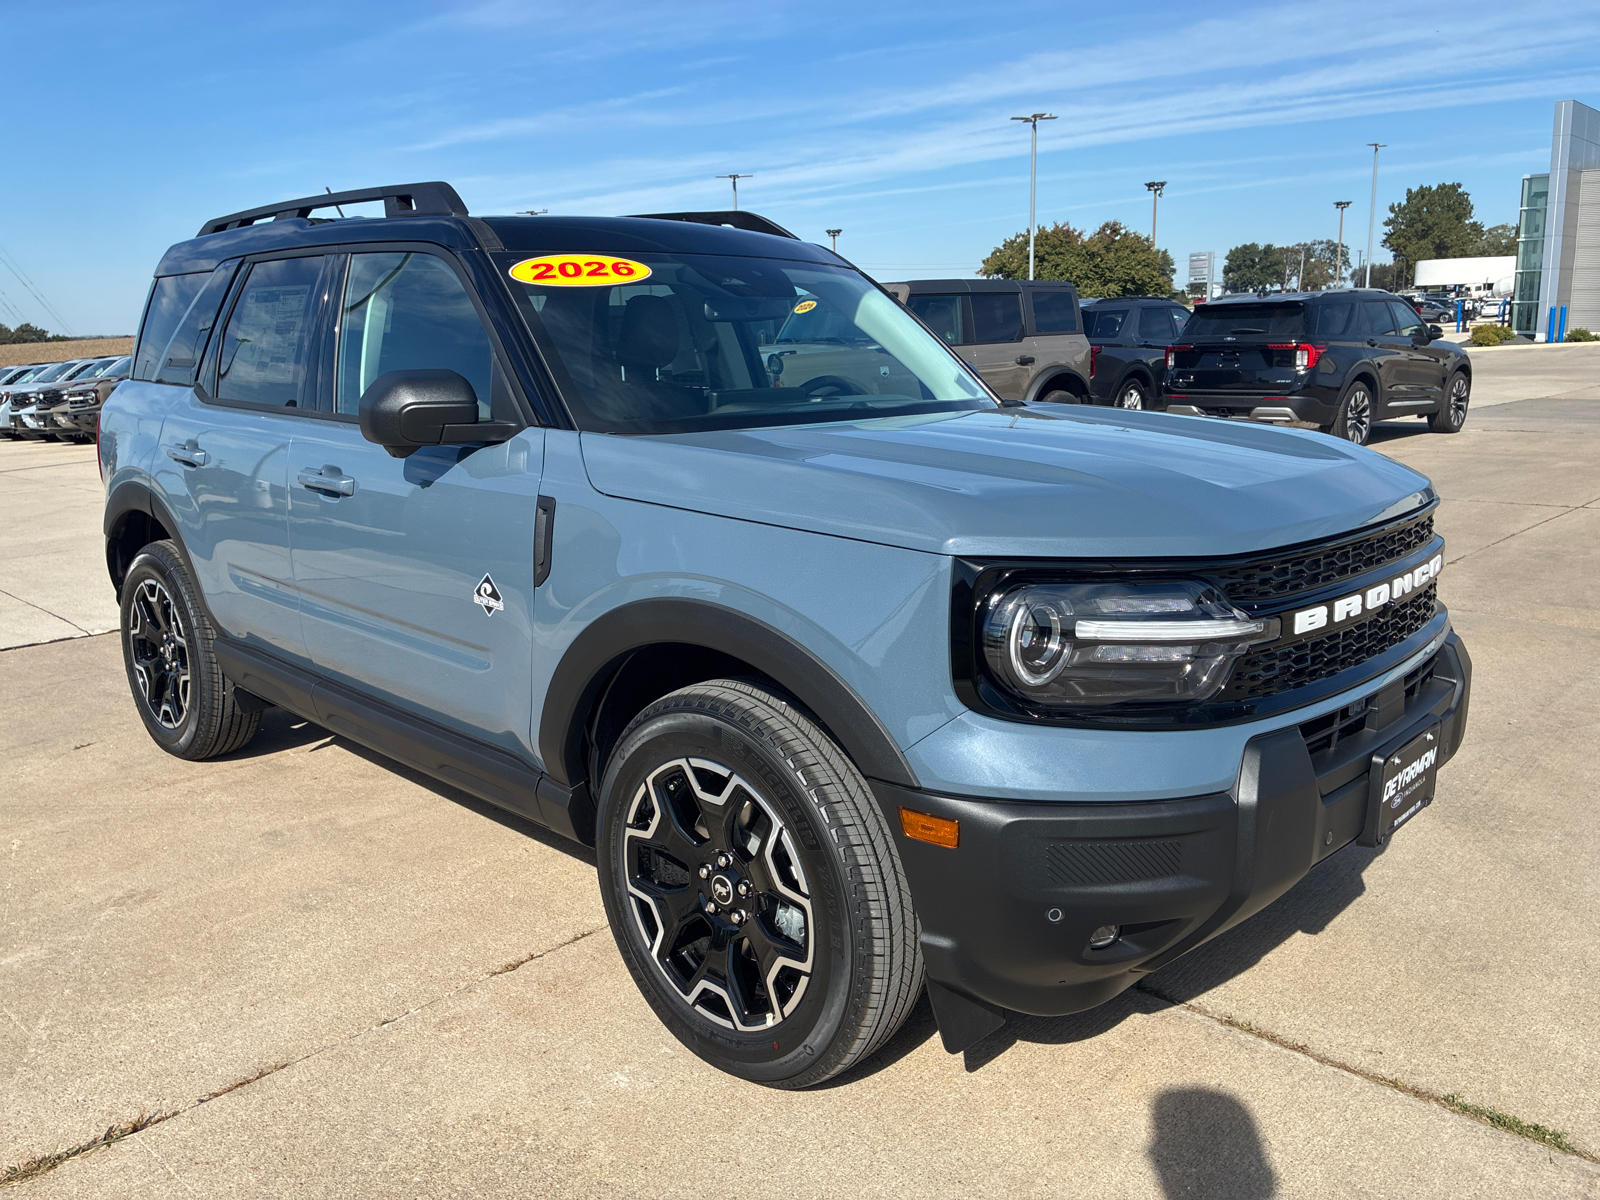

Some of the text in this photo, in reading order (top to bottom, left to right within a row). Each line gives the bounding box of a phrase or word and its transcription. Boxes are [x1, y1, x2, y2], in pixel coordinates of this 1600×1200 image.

[530, 261, 636, 280] 2026
[1294, 554, 1442, 635] BRONCO
[747, 752, 817, 845] MICHELIN
[1383, 746, 1438, 803] DEYARMAN
